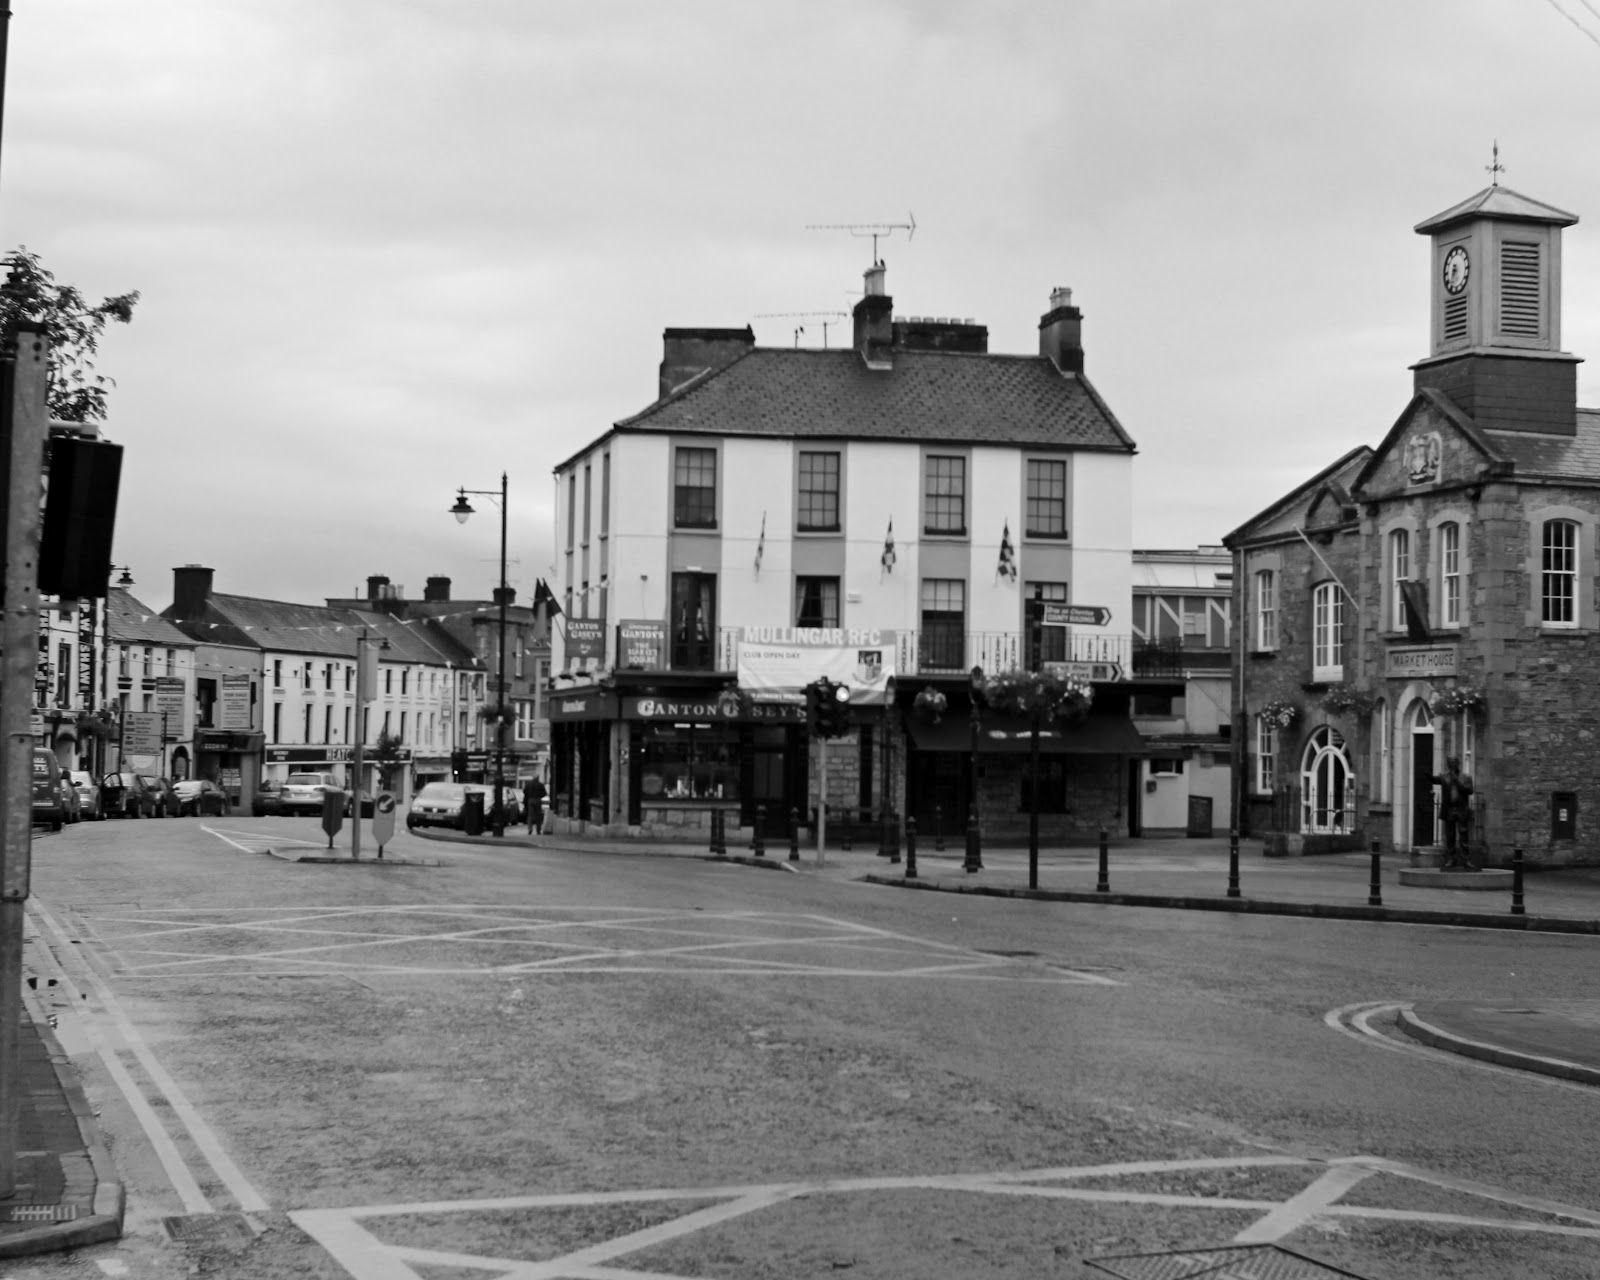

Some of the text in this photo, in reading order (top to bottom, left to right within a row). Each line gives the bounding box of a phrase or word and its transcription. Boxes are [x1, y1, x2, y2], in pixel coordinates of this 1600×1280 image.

[79, 603, 91, 685] P.W. SHAW
[743, 626, 881, 646] MULLINGAR RFC
[743, 651, 761, 659] CLUB
[764, 651, 784, 659] OPEN
[1393, 653, 1454, 668] MARKET HOUSE
[637, 699, 807, 718] CANTON CSEY'S
